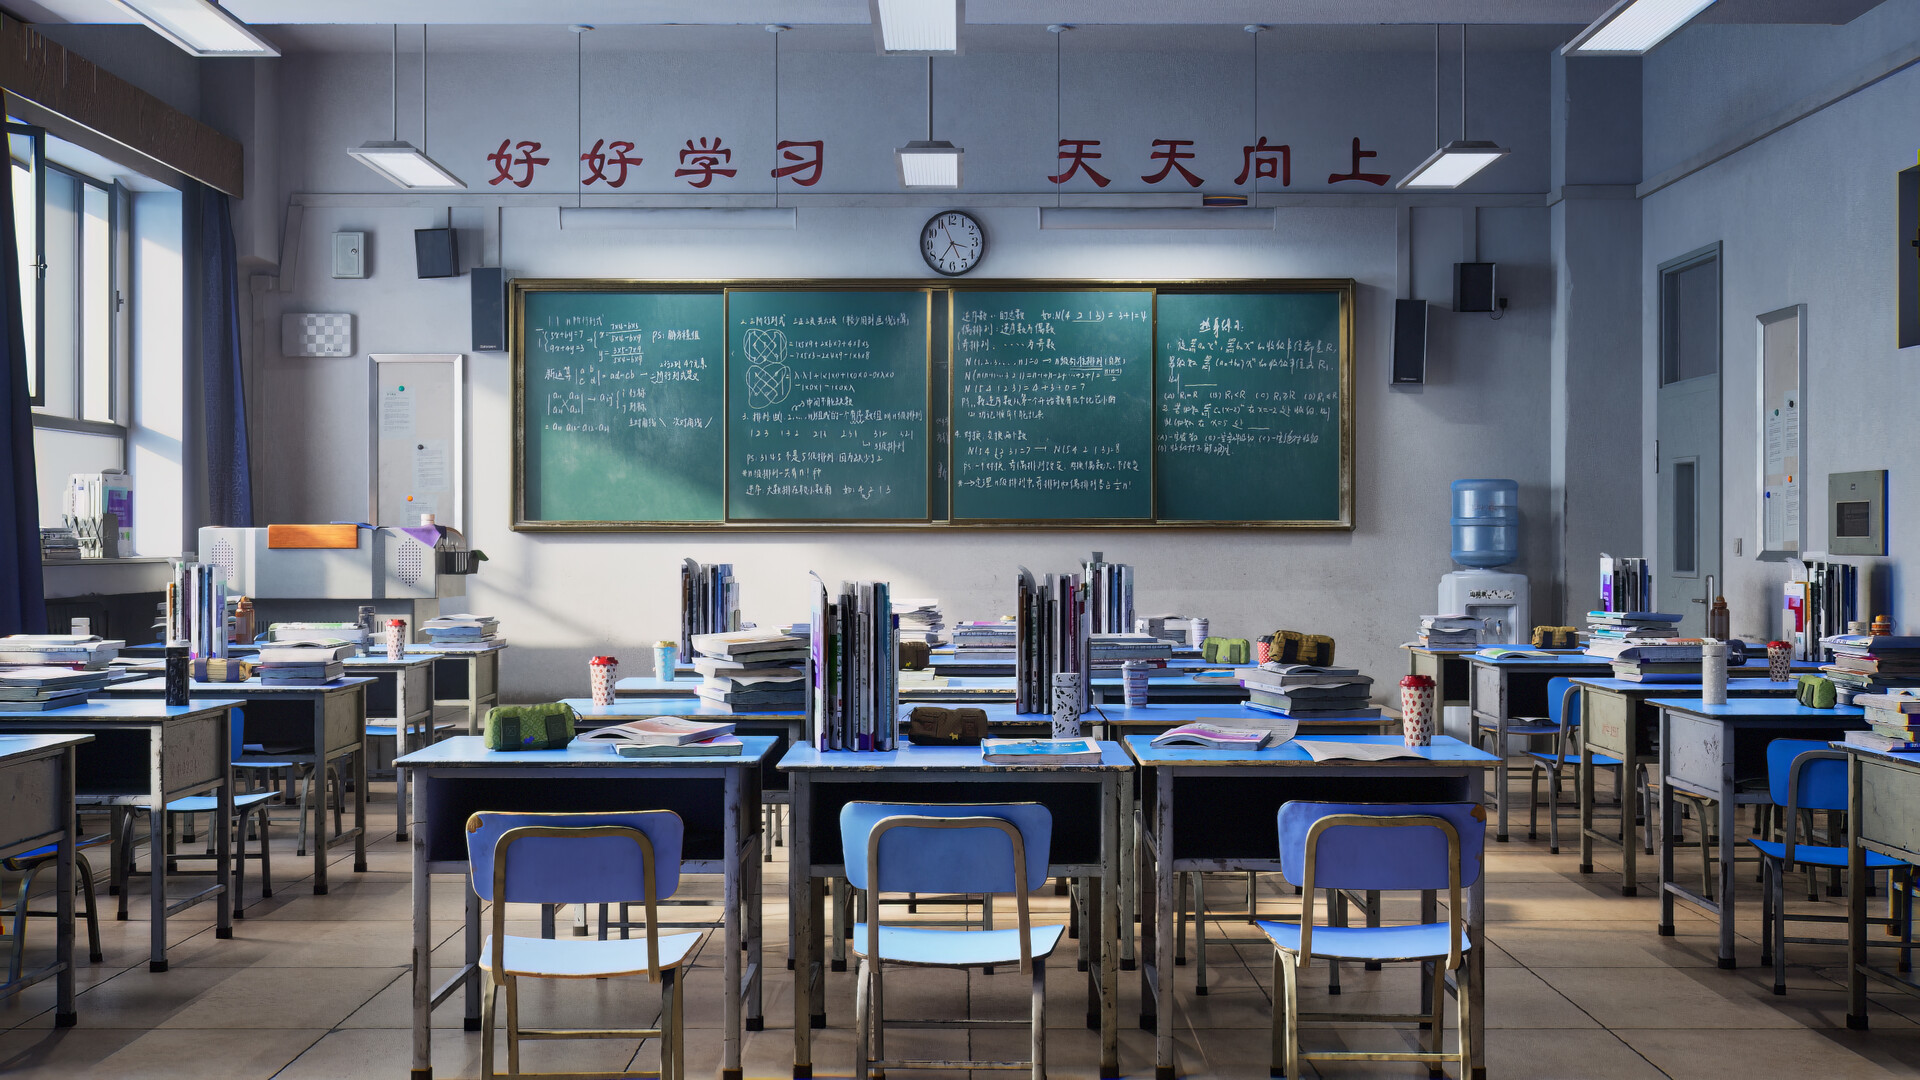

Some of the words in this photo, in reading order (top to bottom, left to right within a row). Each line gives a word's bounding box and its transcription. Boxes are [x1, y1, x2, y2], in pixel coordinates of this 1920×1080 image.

[487, 137, 824, 188] 好好学习
[1047, 136, 1391, 188] 天天向上
[938, 219, 944, 229] 11
[948, 215, 956, 226] 12
[961, 217, 965, 228] 1
[928, 228, 937, 239] 10
[968, 225, 975, 236] 2
[926, 240, 933, 250] 9
[971, 237, 978, 247] 3
[930, 250, 936, 261] 8
[968, 249, 975, 259] 4
[939, 258, 945, 268] 7
[949, 261, 956, 271] 6
[961, 258, 968, 268] 5
